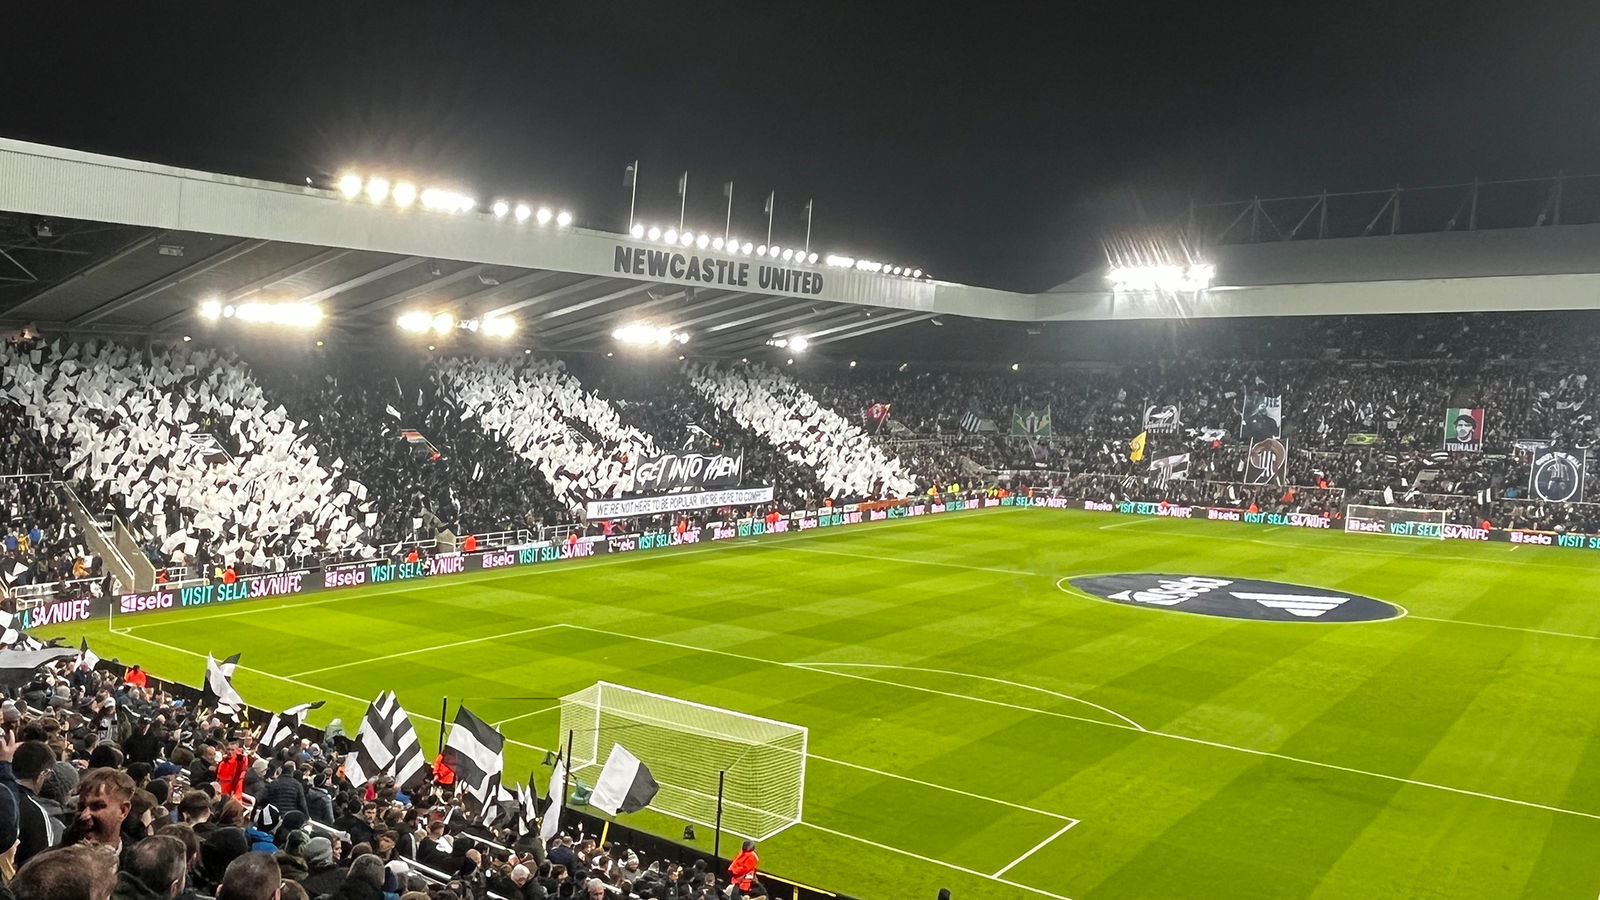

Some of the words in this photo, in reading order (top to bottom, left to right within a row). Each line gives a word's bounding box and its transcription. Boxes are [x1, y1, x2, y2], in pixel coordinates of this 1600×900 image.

[614, 245, 749, 287] NEWCASTLE
[758, 265, 823, 295] UNITED
[636, 454, 676, 487] GET
[668, 453, 703, 484] INTO
[702, 454, 741, 483] THEM
[1217, 511, 1240, 521] sela
[1243, 512, 1267, 523] VISIT
[1390, 522, 1414, 535] VISIT
[638, 535, 655, 549] VISIT
[1523, 533, 1552, 545] sela
[1557, 534, 1586, 547] VISIT
[492, 552, 515, 567] sela
[518, 548, 539, 564] VISIT
[337, 569, 365, 586] sela
[370, 564, 396, 583] VISIT
[136, 591, 173, 611] sela
[181, 585, 214, 607] VISIT
[216, 575, 302, 602] SELA.SA/NUFC
